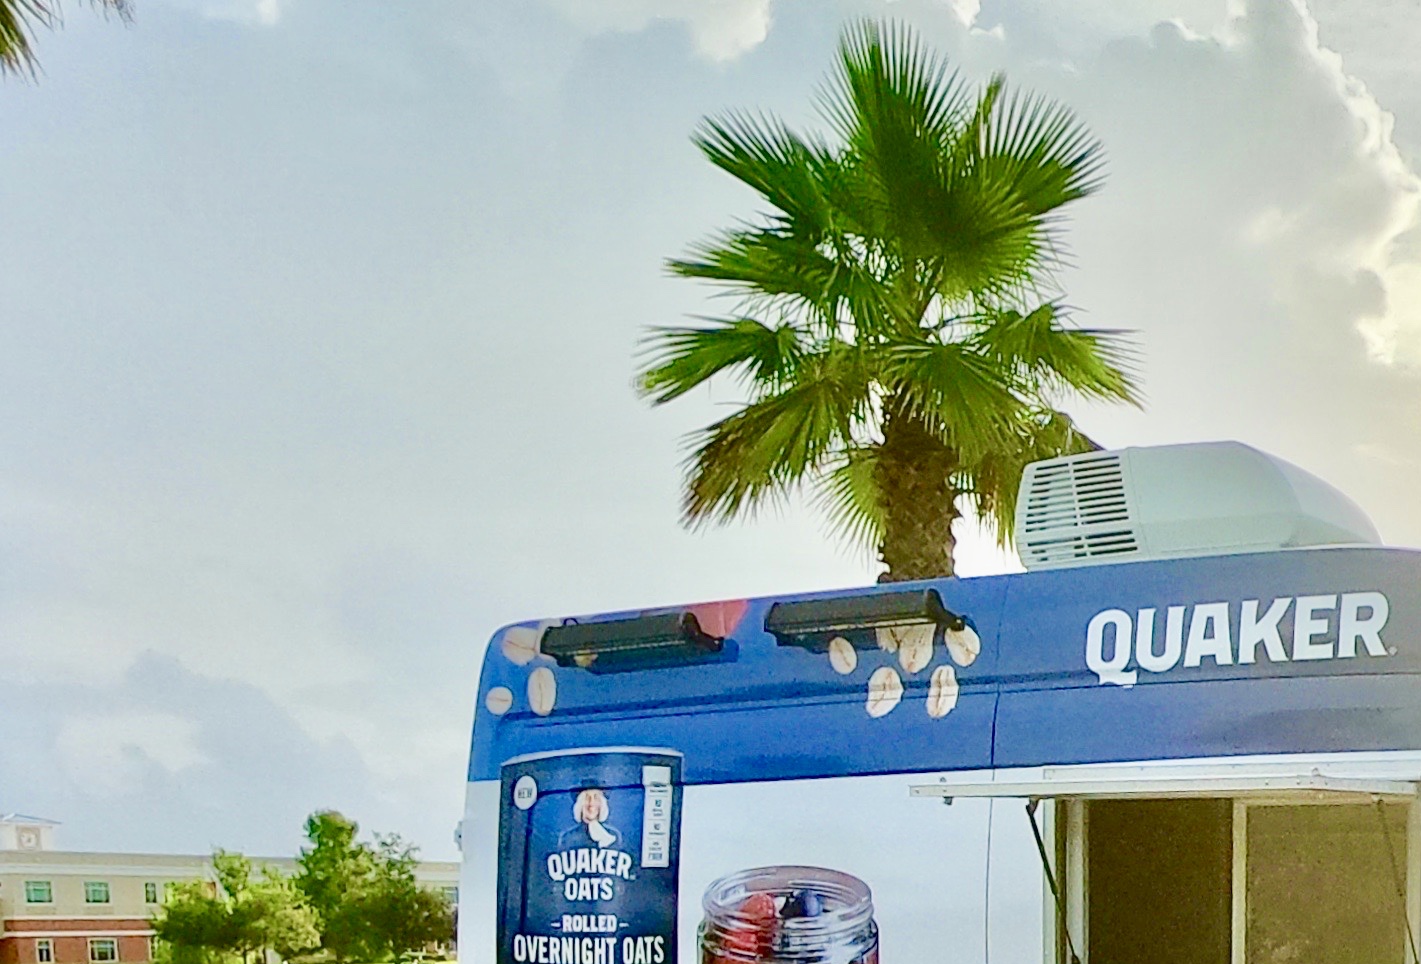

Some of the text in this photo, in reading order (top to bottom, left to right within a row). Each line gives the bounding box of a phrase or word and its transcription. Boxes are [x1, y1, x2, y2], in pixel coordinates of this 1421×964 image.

[1085, 591, 1389, 688] QUAKER
[547, 848, 632, 881] QUAKER
[564, 877, 614, 901] OATS
[562, 914, 618, 933] ROLLED
